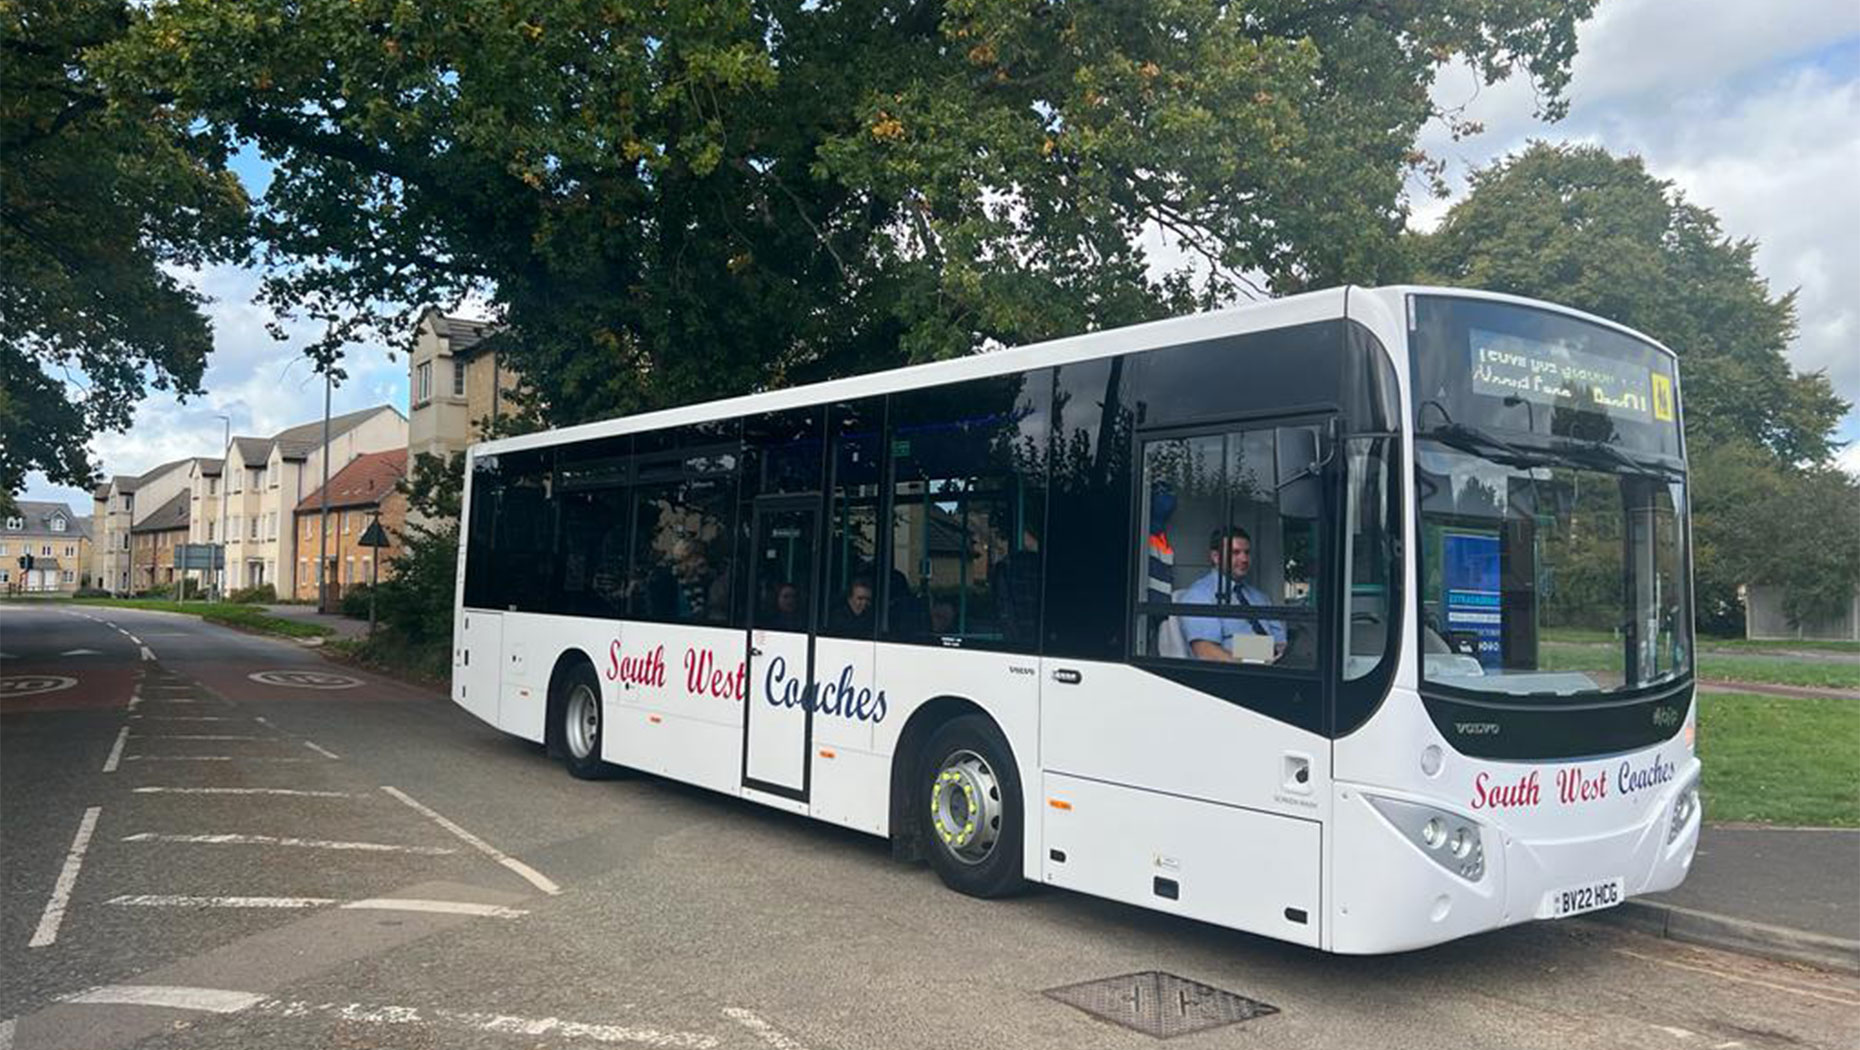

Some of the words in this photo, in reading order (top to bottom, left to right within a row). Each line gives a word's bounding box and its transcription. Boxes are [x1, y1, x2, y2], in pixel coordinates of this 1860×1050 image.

[606, 639, 666, 688] South
[684, 648, 745, 701] West
[765, 656, 887, 723] Coaches
[1456, 722, 1500, 735] VOLVO
[1471, 771, 1541, 809] South
[1556, 767, 1608, 804] West
[1618, 754, 1675, 795] Coaches
[1562, 886, 1594, 914] BV22
[1596, 882, 1618, 908] HCG
